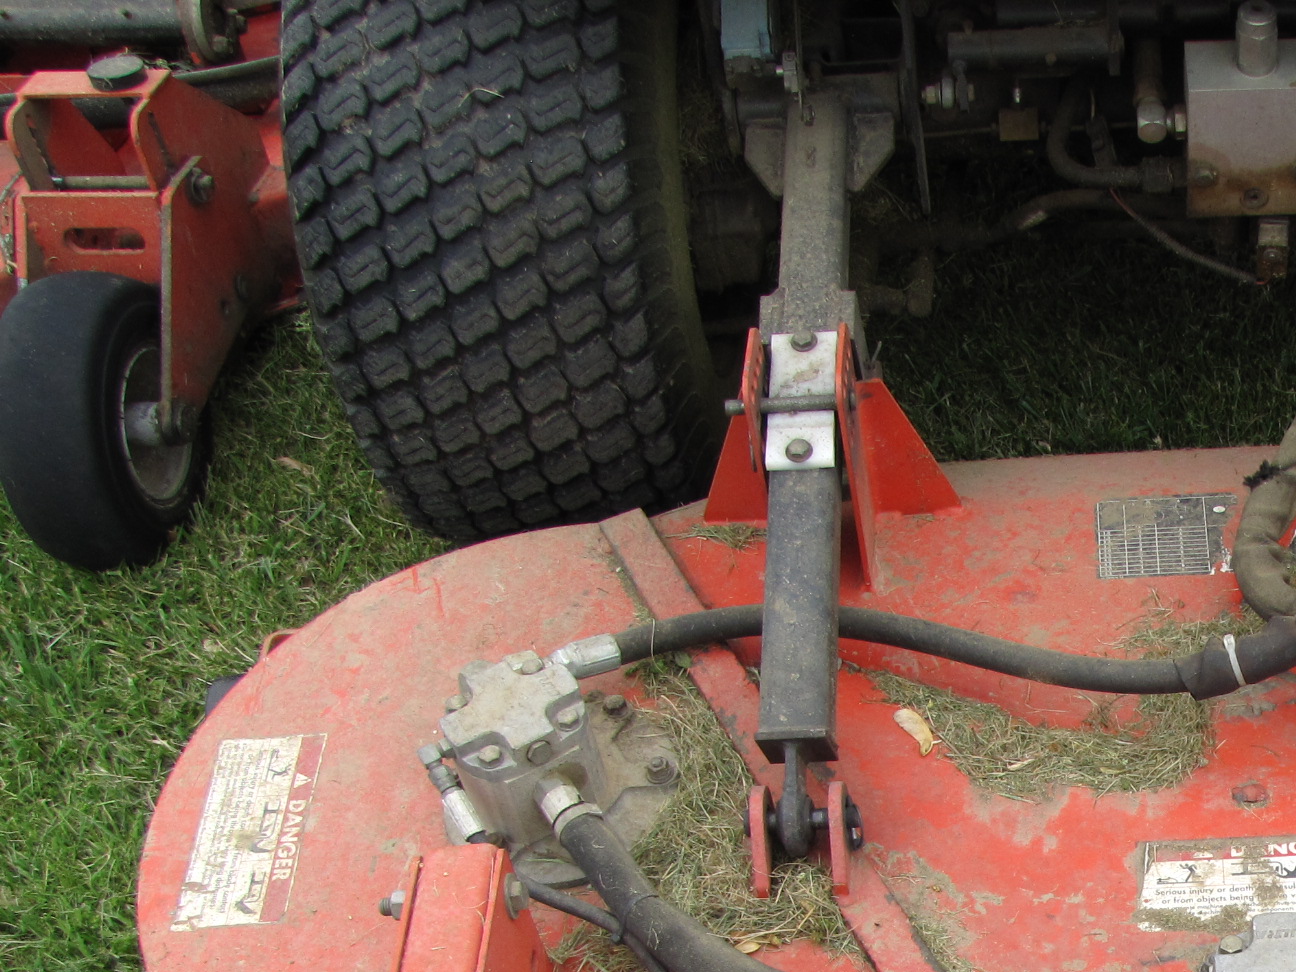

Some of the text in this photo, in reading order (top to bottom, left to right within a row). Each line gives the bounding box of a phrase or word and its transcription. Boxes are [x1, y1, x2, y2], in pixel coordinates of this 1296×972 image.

[272, 799, 306, 881] DANGER
[1189, 886, 1213, 895] injury
[1229, 884, 1253, 892] death
[1197, 894, 1226, 903] objects
[1229, 893, 1253, 902] being
